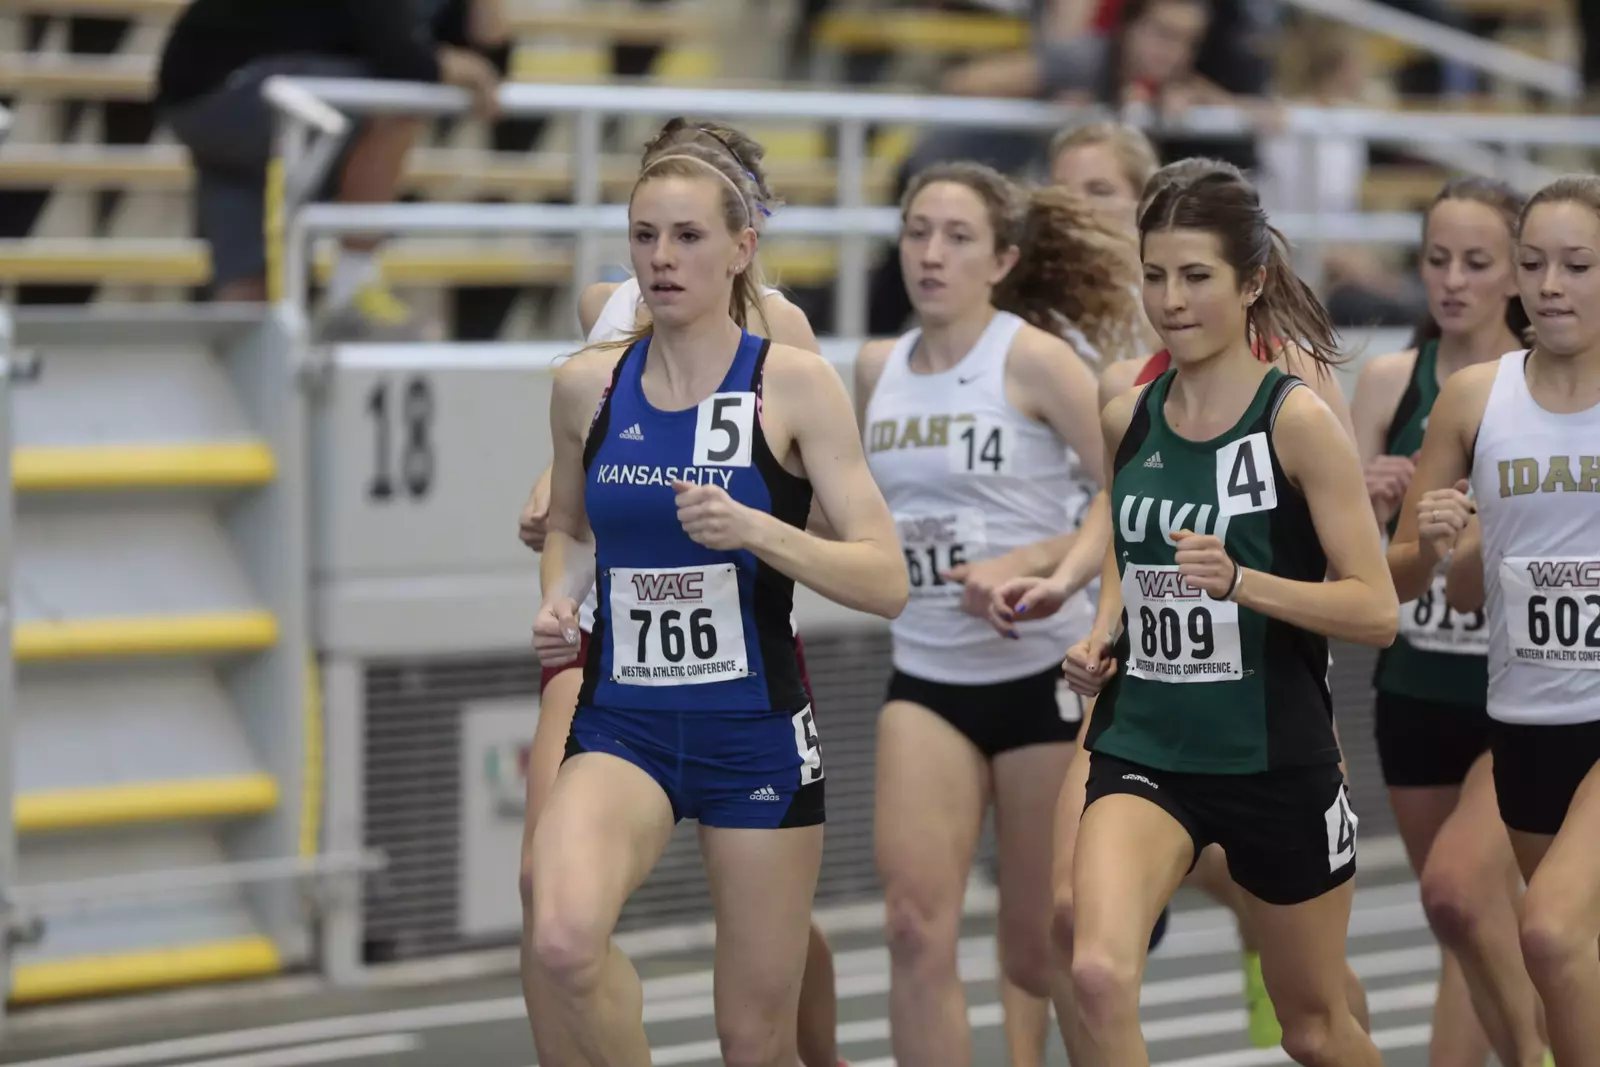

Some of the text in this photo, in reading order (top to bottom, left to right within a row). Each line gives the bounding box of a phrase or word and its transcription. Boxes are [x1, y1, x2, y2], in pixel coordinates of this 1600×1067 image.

[365, 374, 436, 500] 18
[706, 397, 742, 462] 5
[870, 412, 977, 453] IDAH
[960, 426, 1006, 472] 14
[597, 464, 733, 490] KANSAS CITY
[1227, 440, 1266, 507] 4
[1119, 495, 1231, 547] UVU
[632, 572, 704, 601] WAC
[1527, 561, 1600, 587] WAC
[630, 608, 718, 663] 766
[1139, 605, 1215, 661] 809
[1528, 594, 1600, 647] 602
[621, 660, 736, 678] WESTERN ATHLETIC CONFERENCE
[1156, 661, 1181, 675] ATHLETIC
[1183, 662, 1232, 675] CONFERENCE
[1516, 648, 1544, 660] WESTERN
[1546, 649, 1576, 661] ATHLETIC
[801, 711, 823, 779] 5
[1336, 796, 1356, 855] 4
